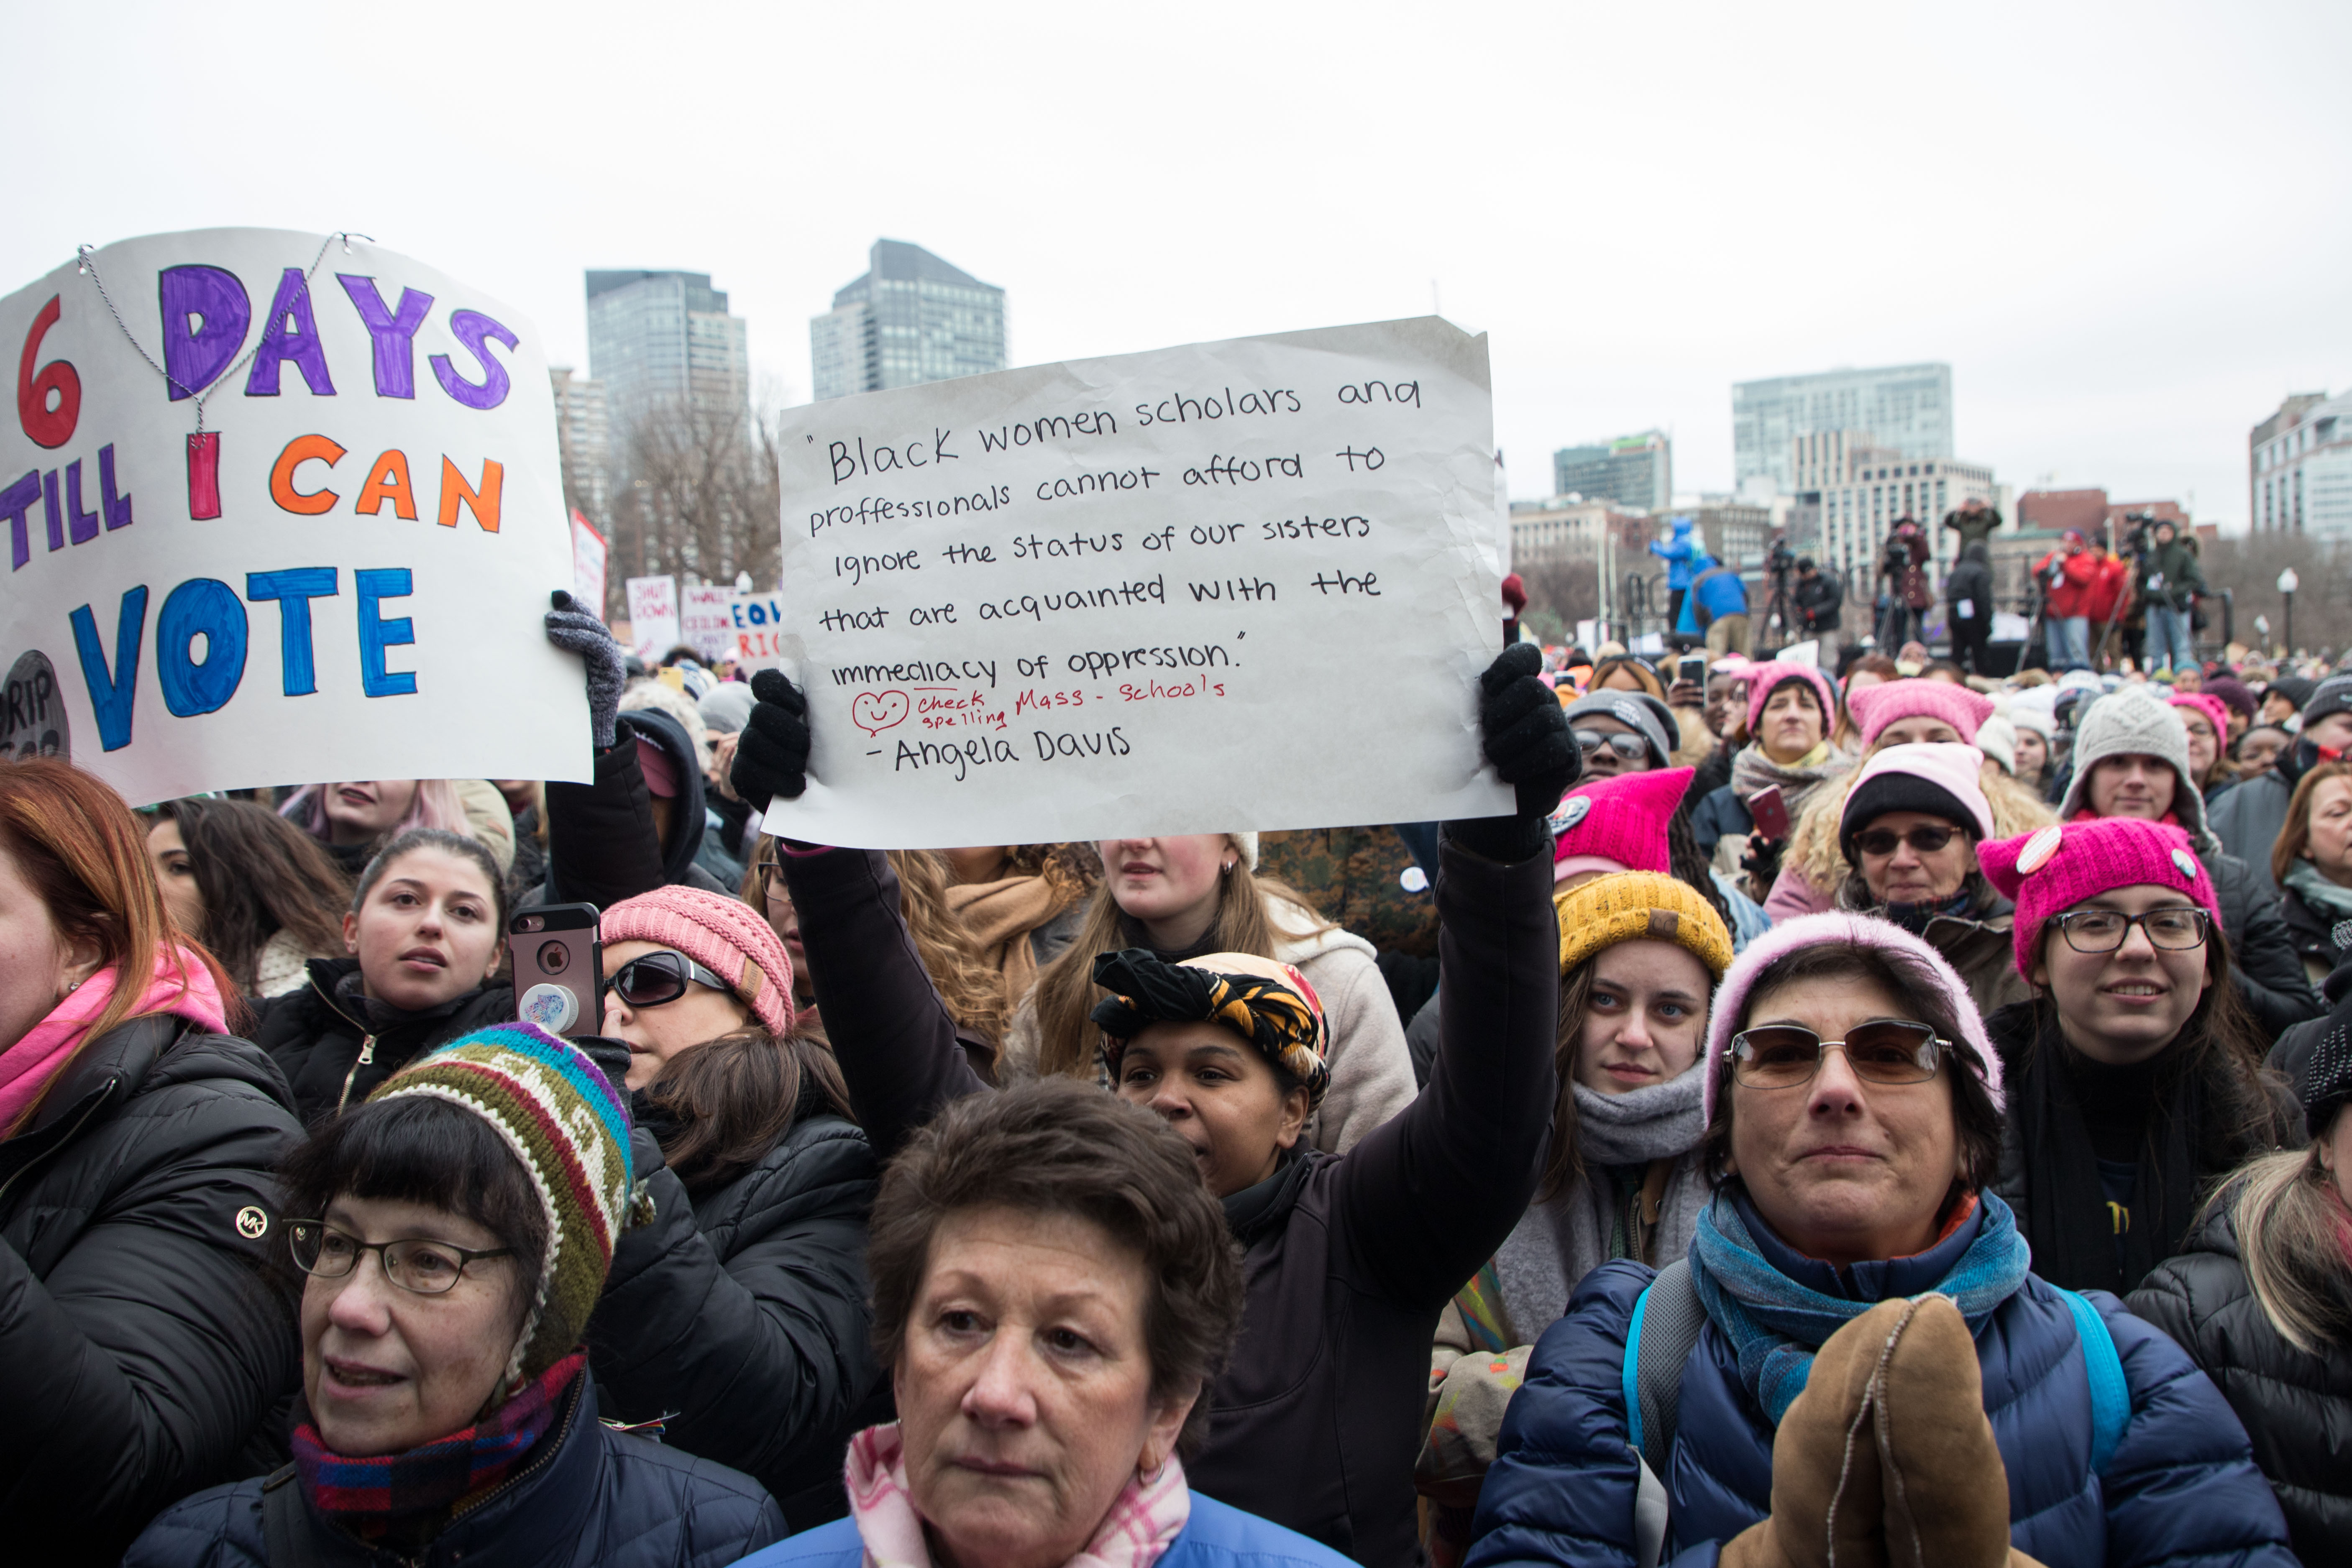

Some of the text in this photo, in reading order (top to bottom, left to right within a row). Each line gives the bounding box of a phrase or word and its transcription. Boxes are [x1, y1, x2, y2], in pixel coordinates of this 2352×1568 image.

[18, 264, 517, 449] 6 DAYS
[979, 412, 1116, 452] women
[1136, 387, 1300, 426] scholars
[0, 432, 504, 572] TILL I CAN
[811, 445, 1385, 537] proffessionals cannot afford to
[942, 543, 996, 564] the
[1013, 532, 1122, 559] status
[1142, 526, 1175, 551] of
[1190, 524, 1244, 545] our
[1262, 516, 1369, 540] sisters
[635, 582, 667, 599] SHUT
[636, 602, 676, 619] DOWN
[819, 570, 1381, 632] that are acquainted with the
[69, 567, 417, 752] VOTE
[832, 659, 996, 688] immediacy
[1017, 655, 1048, 679] of
[8, 670, 52, 734] RIP
[922, 709, 1007, 731] spelling
[1016, 689, 1083, 715] Mass
[896, 737, 1019, 781] Angela
[1034, 727, 1130, 761] Davis
[238, 1210, 265, 1235] MK
